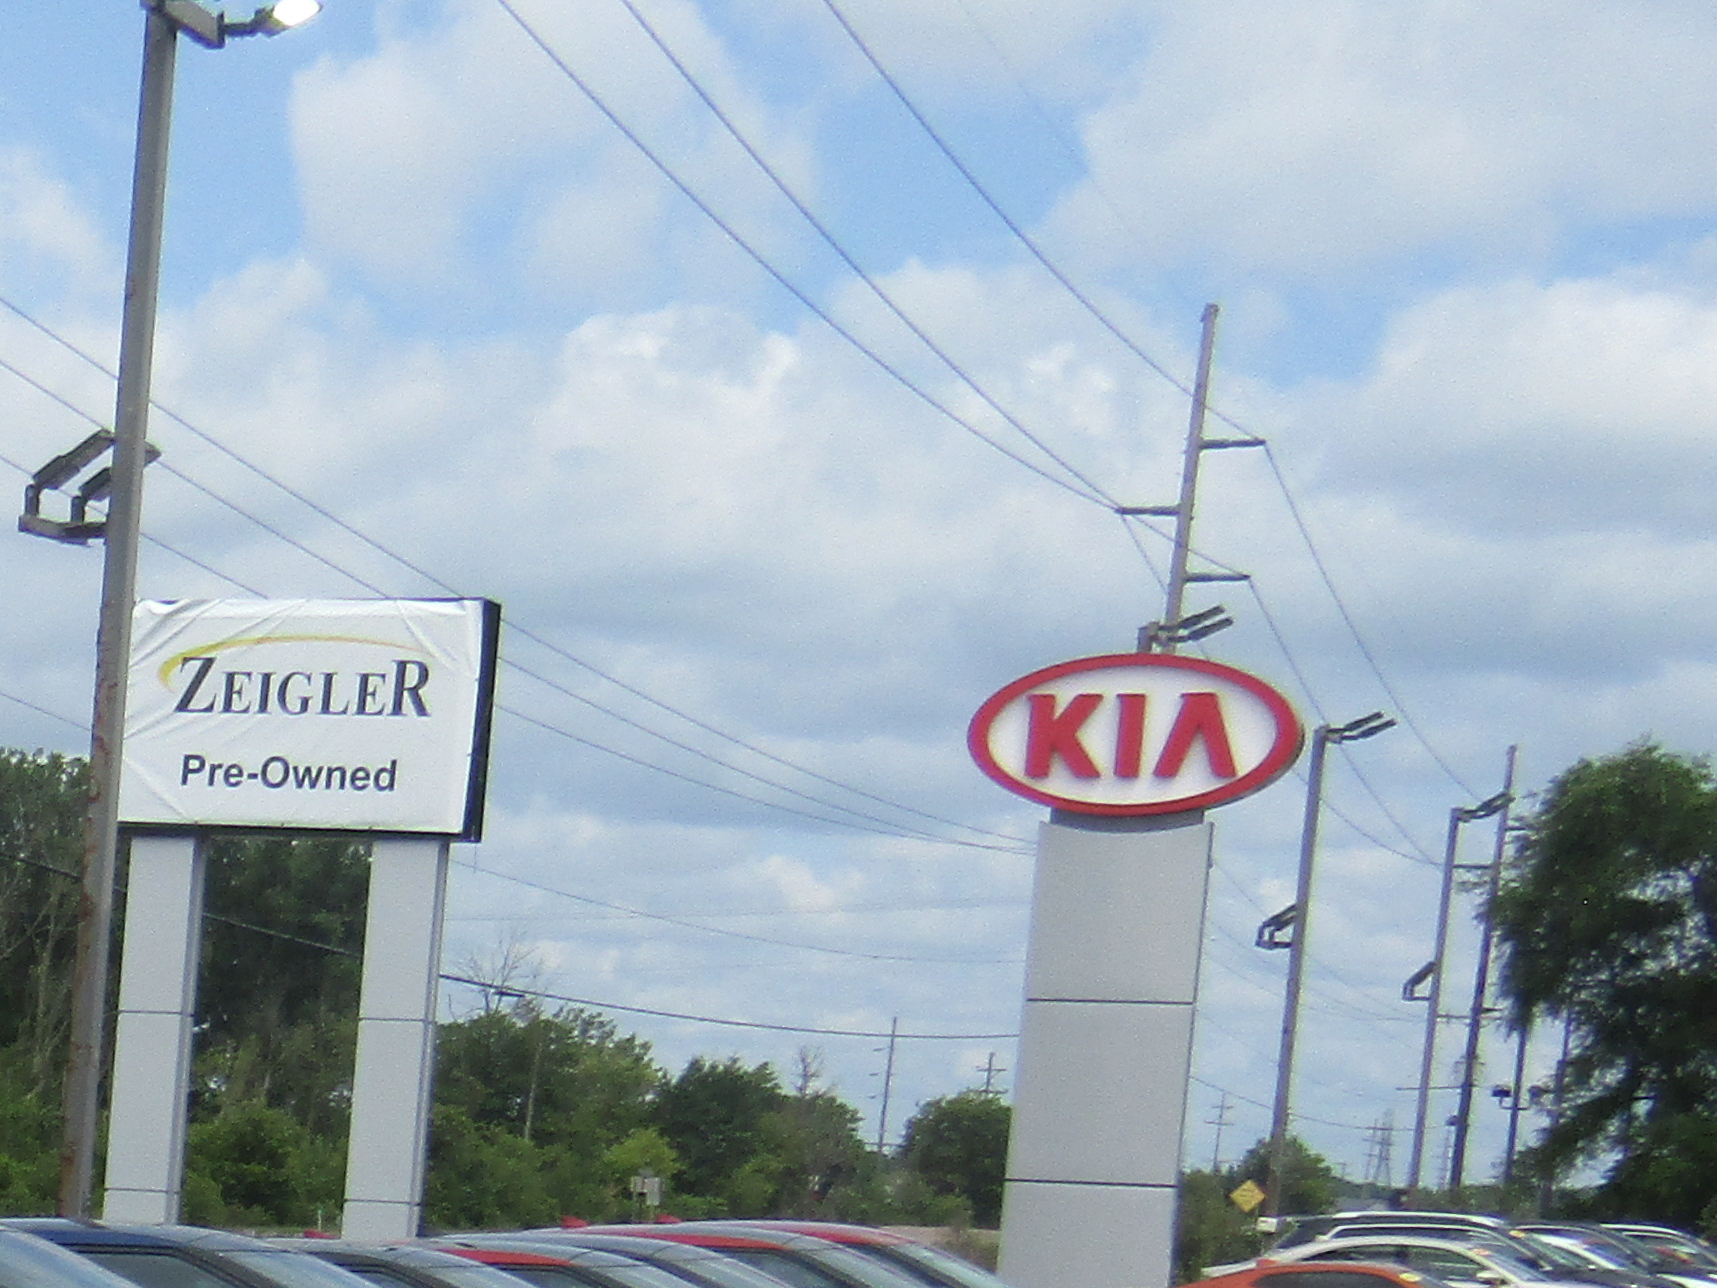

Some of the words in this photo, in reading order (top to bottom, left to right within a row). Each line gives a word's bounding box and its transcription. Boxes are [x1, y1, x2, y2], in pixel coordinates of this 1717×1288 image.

[174, 656, 431, 718] ZEIGLER
[1023, 692, 1238, 779] KIA
[180, 753, 398, 792] Pre-Owned
